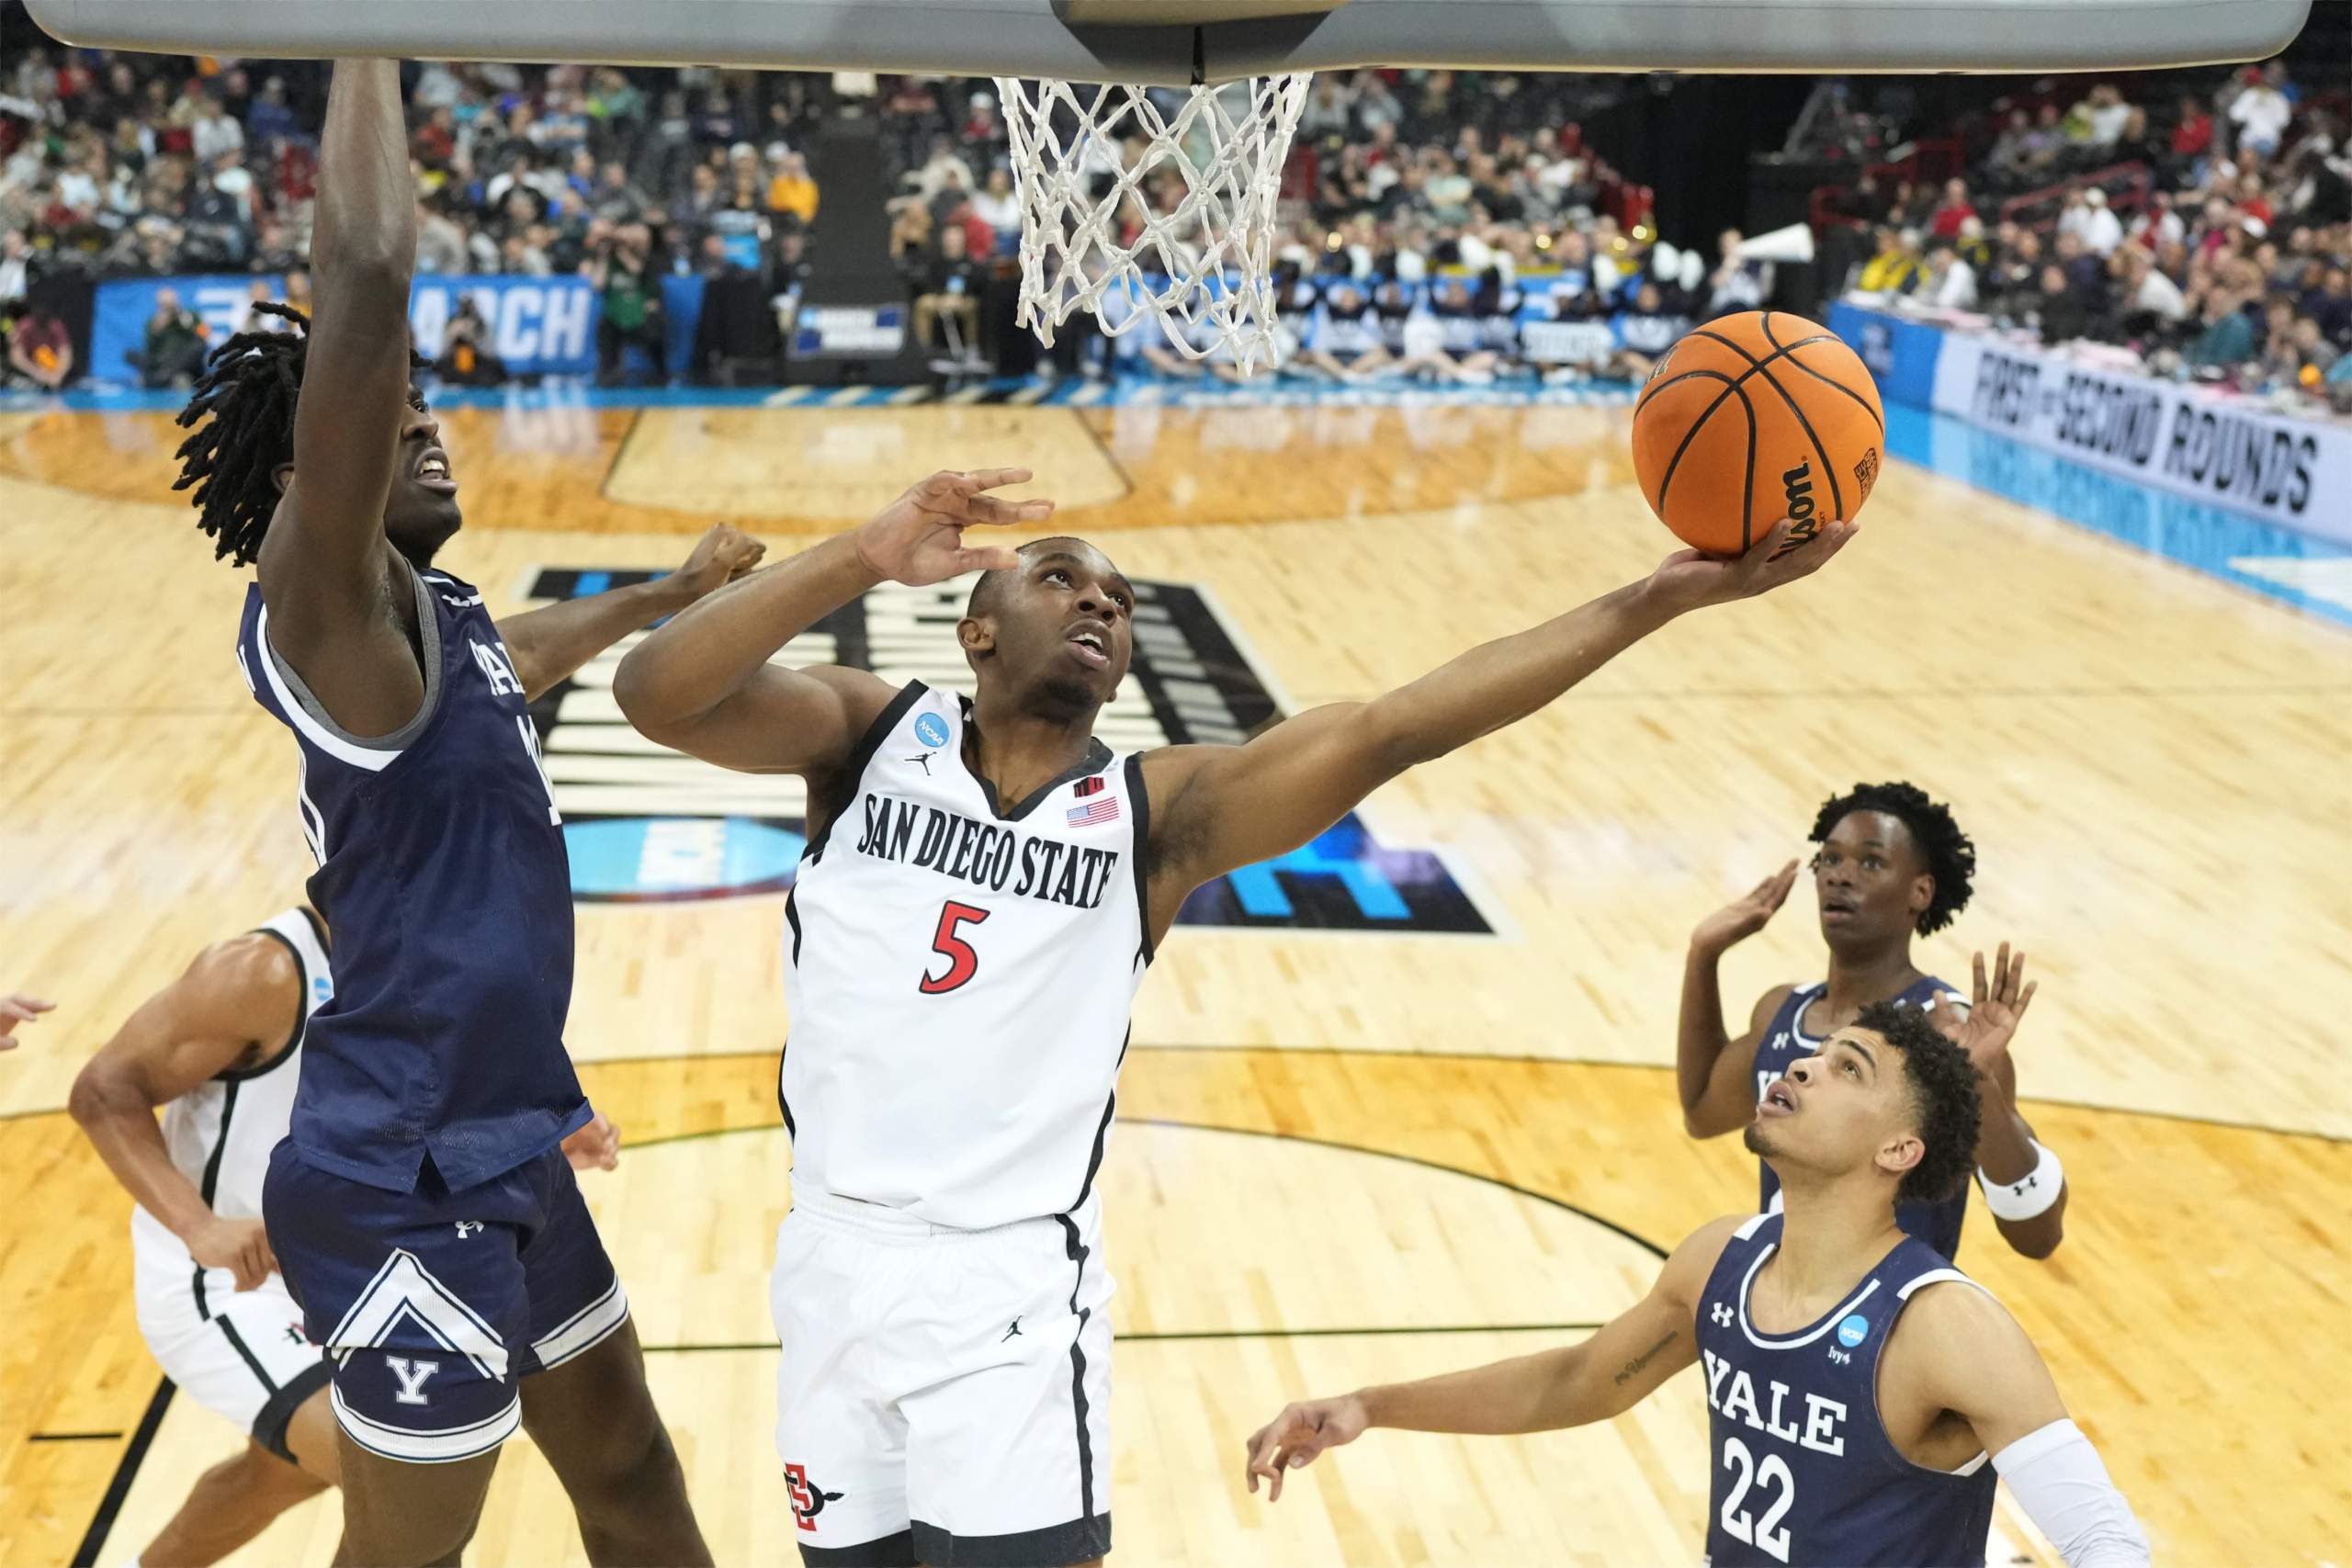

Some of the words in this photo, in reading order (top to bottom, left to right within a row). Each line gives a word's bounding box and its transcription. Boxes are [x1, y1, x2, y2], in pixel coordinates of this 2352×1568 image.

[412, 286, 591, 357] ACH
[2054, 372, 2161, 466] SECOND
[2165, 399, 2317, 515] ROUNDS
[919, 720, 944, 745] NCAA
[856, 793, 922, 864] SAN
[911, 808, 1016, 892] DIEGO
[1013, 836, 1119, 909] STATE
[919, 899, 991, 995] 5
[386, 1355, 439, 1405] Y
[1703, 1348, 1849, 1457] YALE
[1721, 1437, 1795, 1563] 22
